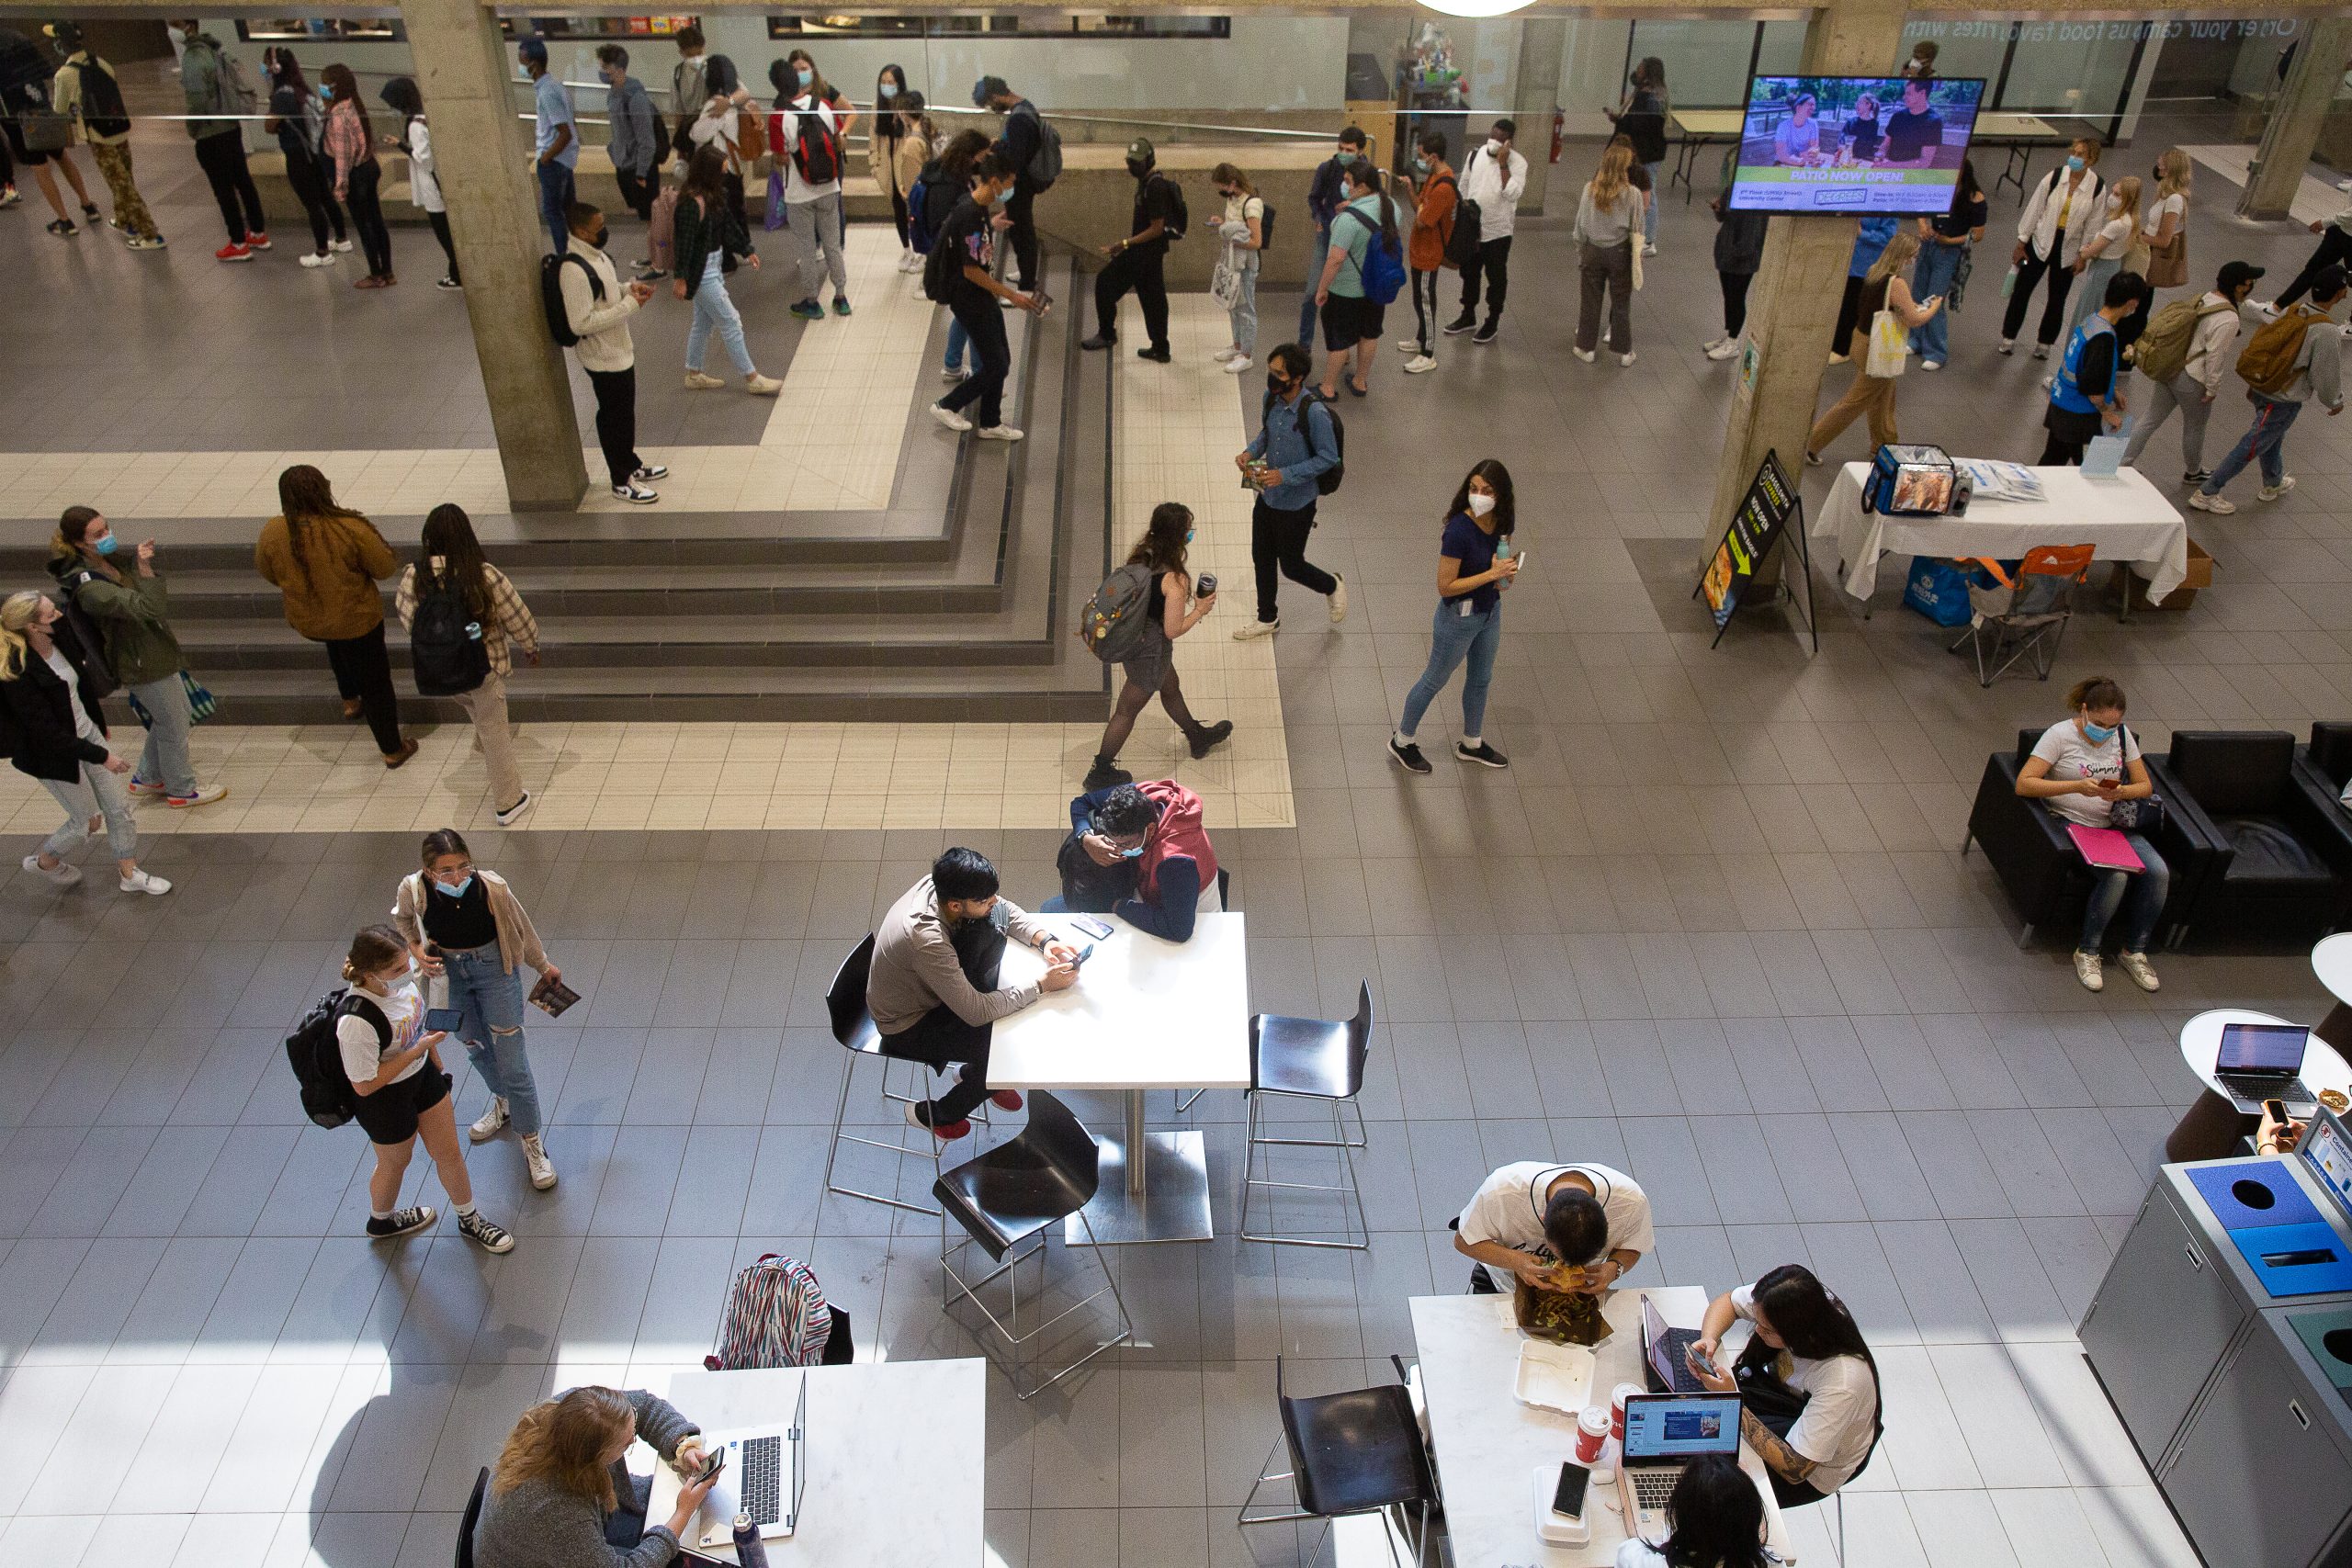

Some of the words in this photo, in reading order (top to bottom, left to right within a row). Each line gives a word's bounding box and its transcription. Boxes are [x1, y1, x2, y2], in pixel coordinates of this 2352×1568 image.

[1791, 170, 1828, 182] PATIO
[1829, 171, 1864, 182] NOW
[1865, 172, 1905, 183] OPEN!
[1765, 480, 1781, 506] EXPRESS
[1750, 496, 1761, 514] NOW
[1757, 511, 1770, 532] OPEN
[2086, 764, 2122, 777] Summer
